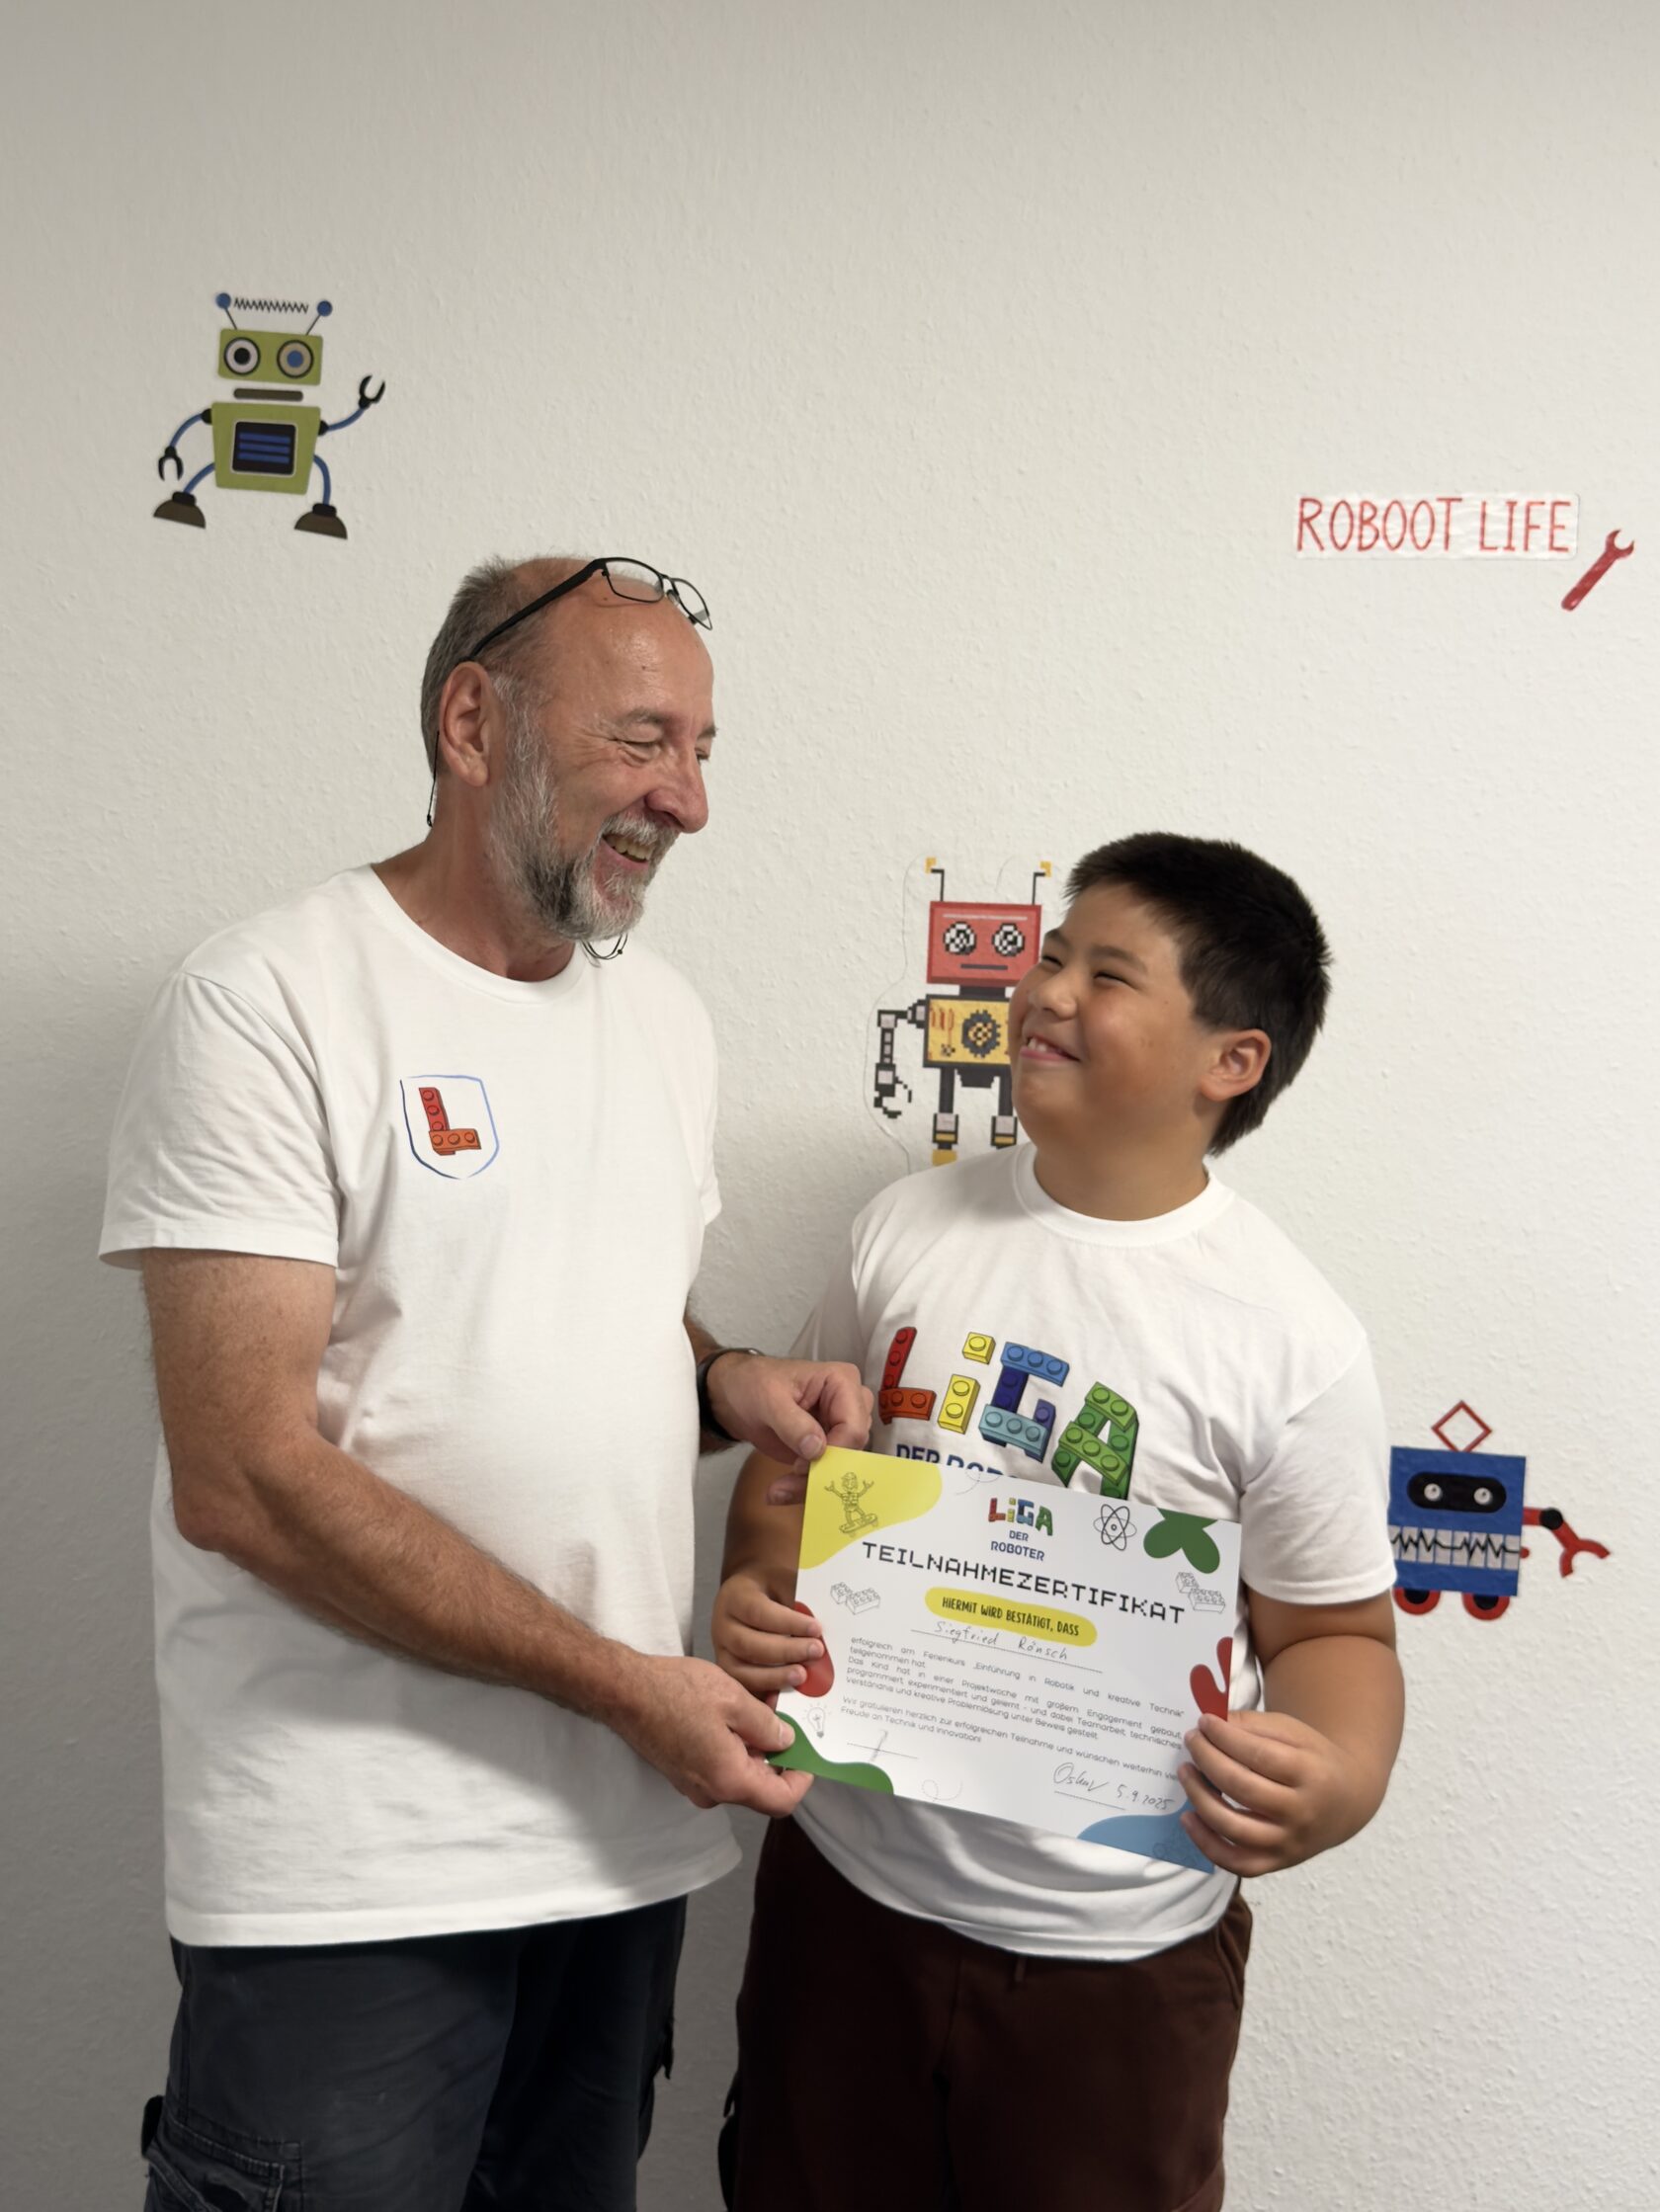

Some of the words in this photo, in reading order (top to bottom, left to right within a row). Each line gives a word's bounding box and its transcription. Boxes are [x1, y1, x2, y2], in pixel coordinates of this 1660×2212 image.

[1296, 497, 1462, 551] ROBOOT
[1478, 500, 1571, 553] LIFE
[1009, 1529, 1030, 1542] DER
[990, 1540, 1045, 1562] ROBOTER
[862, 1541, 1186, 1624] TEILNAHMEZERTIFIKAT
[934, 1620, 1000, 1645] Siegfried
[1056, 1620, 1080, 1637] DASS
[848, 1655, 865, 1667] Das
[1024, 1693, 1039, 1704] mit
[1086, 1708, 1143, 1729] Engagement
[895, 1685, 913, 1697] und
[1028, 1674, 1037, 1682] in
[1083, 1686, 1101, 1698] und
[970, 1692, 988, 1703] und
[1031, 1706, 1047, 1717] und
[917, 1722, 935, 1734] und
[1055, 1744, 1074, 1756] und
